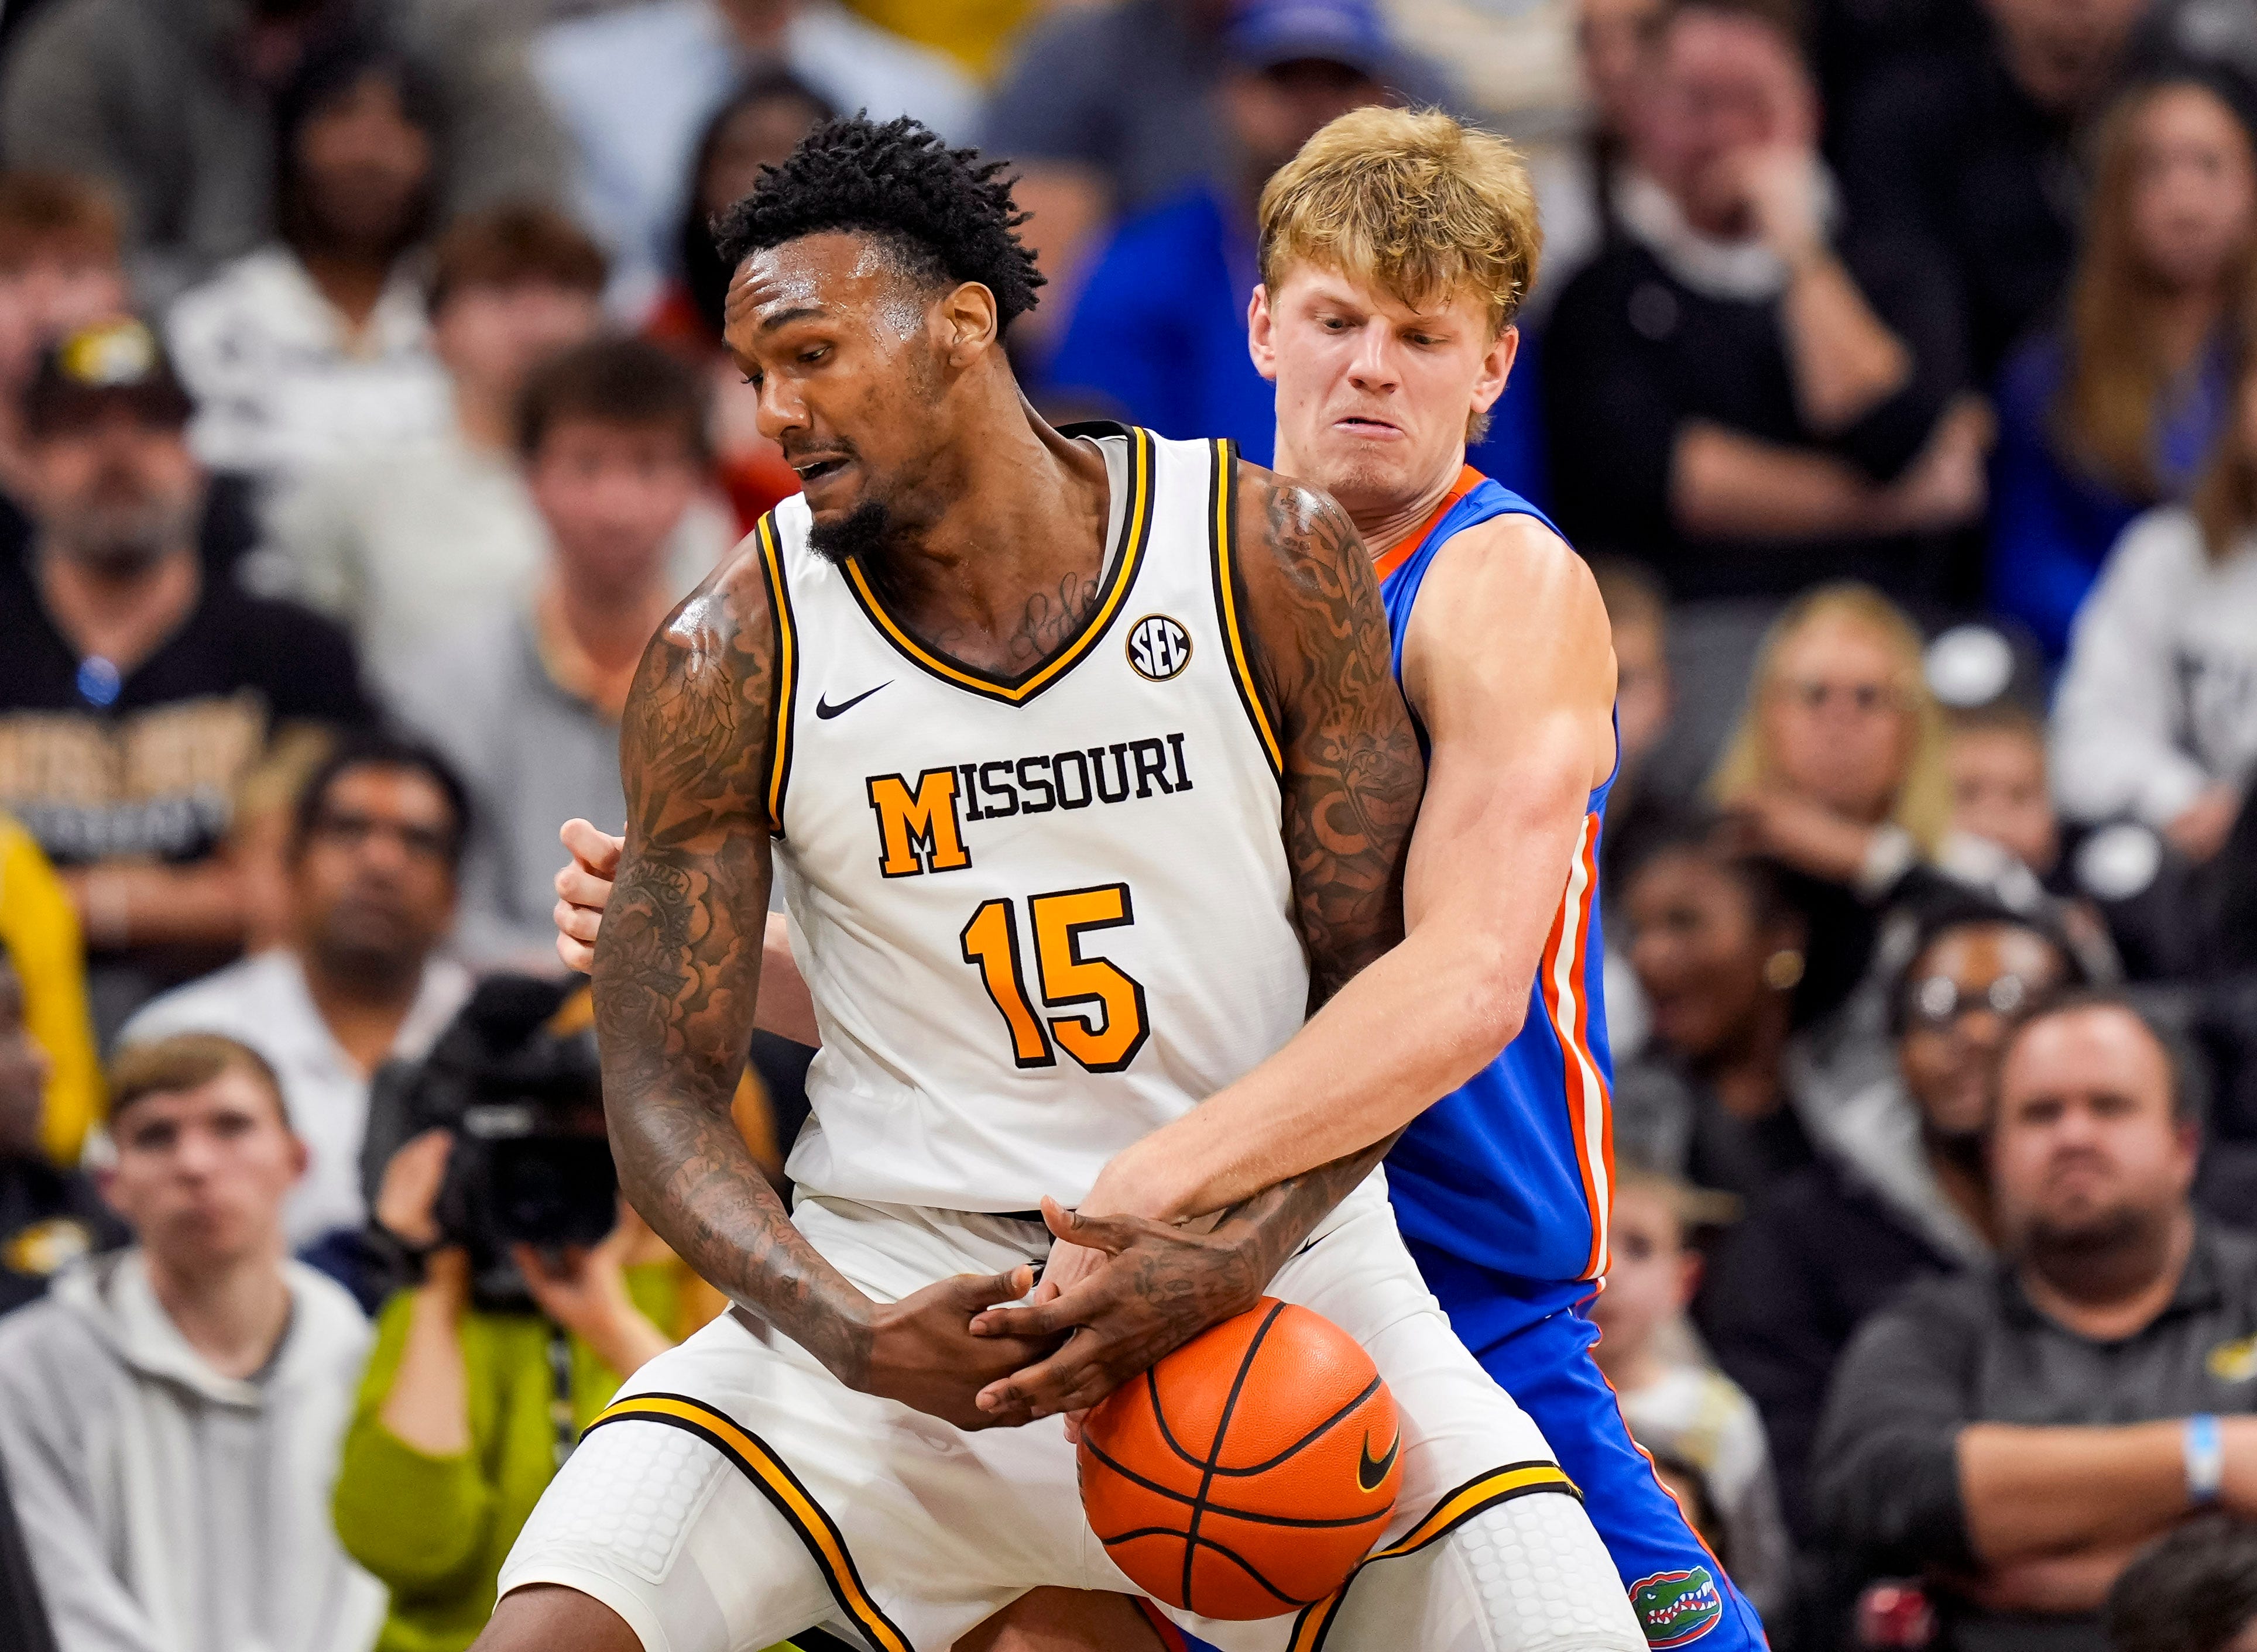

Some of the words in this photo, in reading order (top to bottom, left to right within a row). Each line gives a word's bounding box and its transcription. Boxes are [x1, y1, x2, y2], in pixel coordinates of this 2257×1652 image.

[1130, 618, 1188, 677] SEC
[866, 733, 1193, 878] MISSOURI
[961, 882, 1150, 1074] 15
